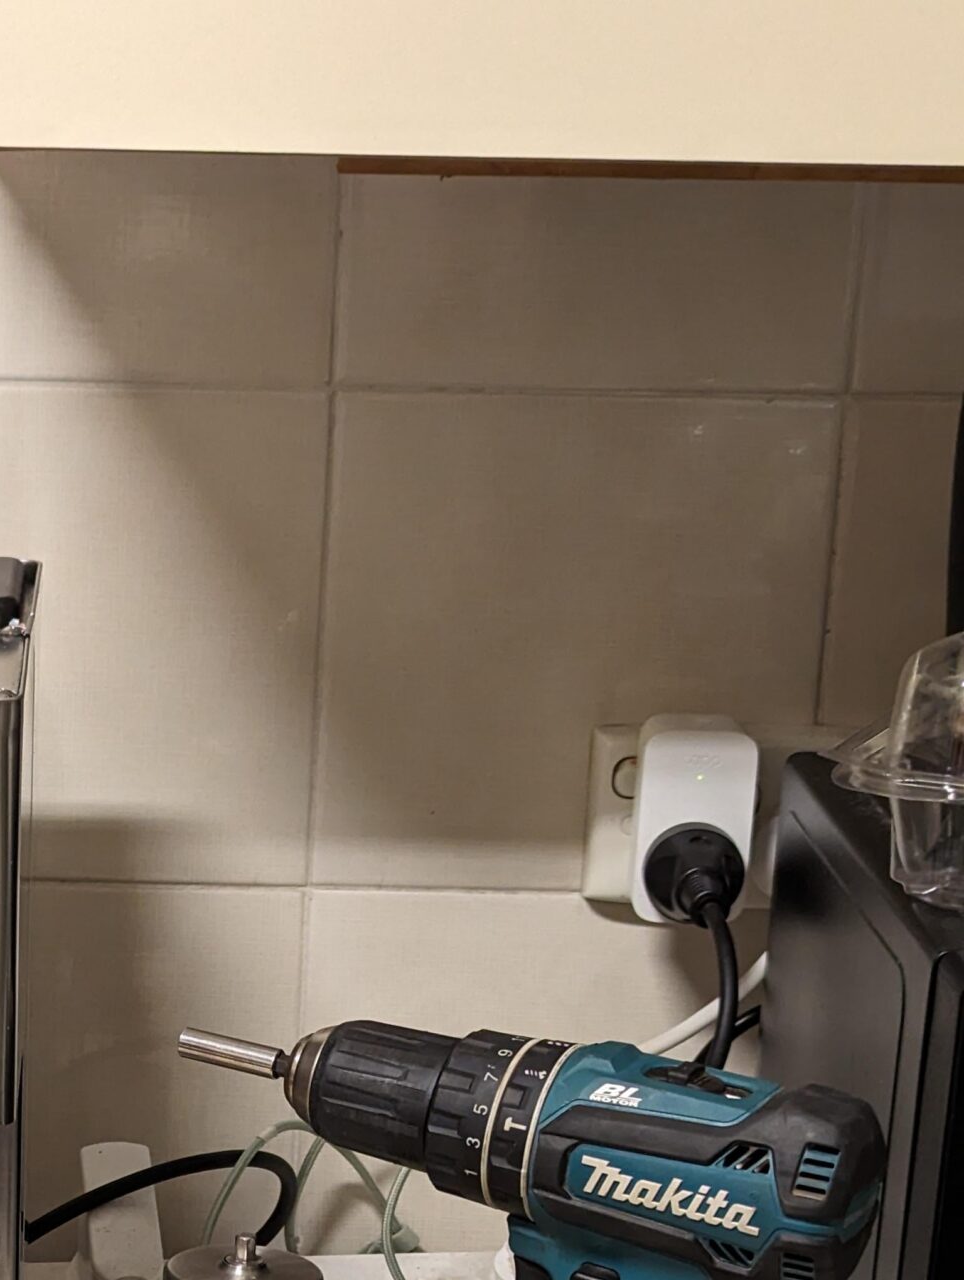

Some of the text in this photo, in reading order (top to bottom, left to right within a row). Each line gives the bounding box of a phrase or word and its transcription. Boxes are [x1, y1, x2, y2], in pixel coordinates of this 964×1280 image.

[484, 1071, 499, 1083] 7
[589, 1083, 643, 1101] BL
[589, 1094, 639, 1108] MOTOR
[473, 1104, 488, 1116] 5
[503, 1116, 527, 1132] T
[466, 1136, 481, 1149] 3
